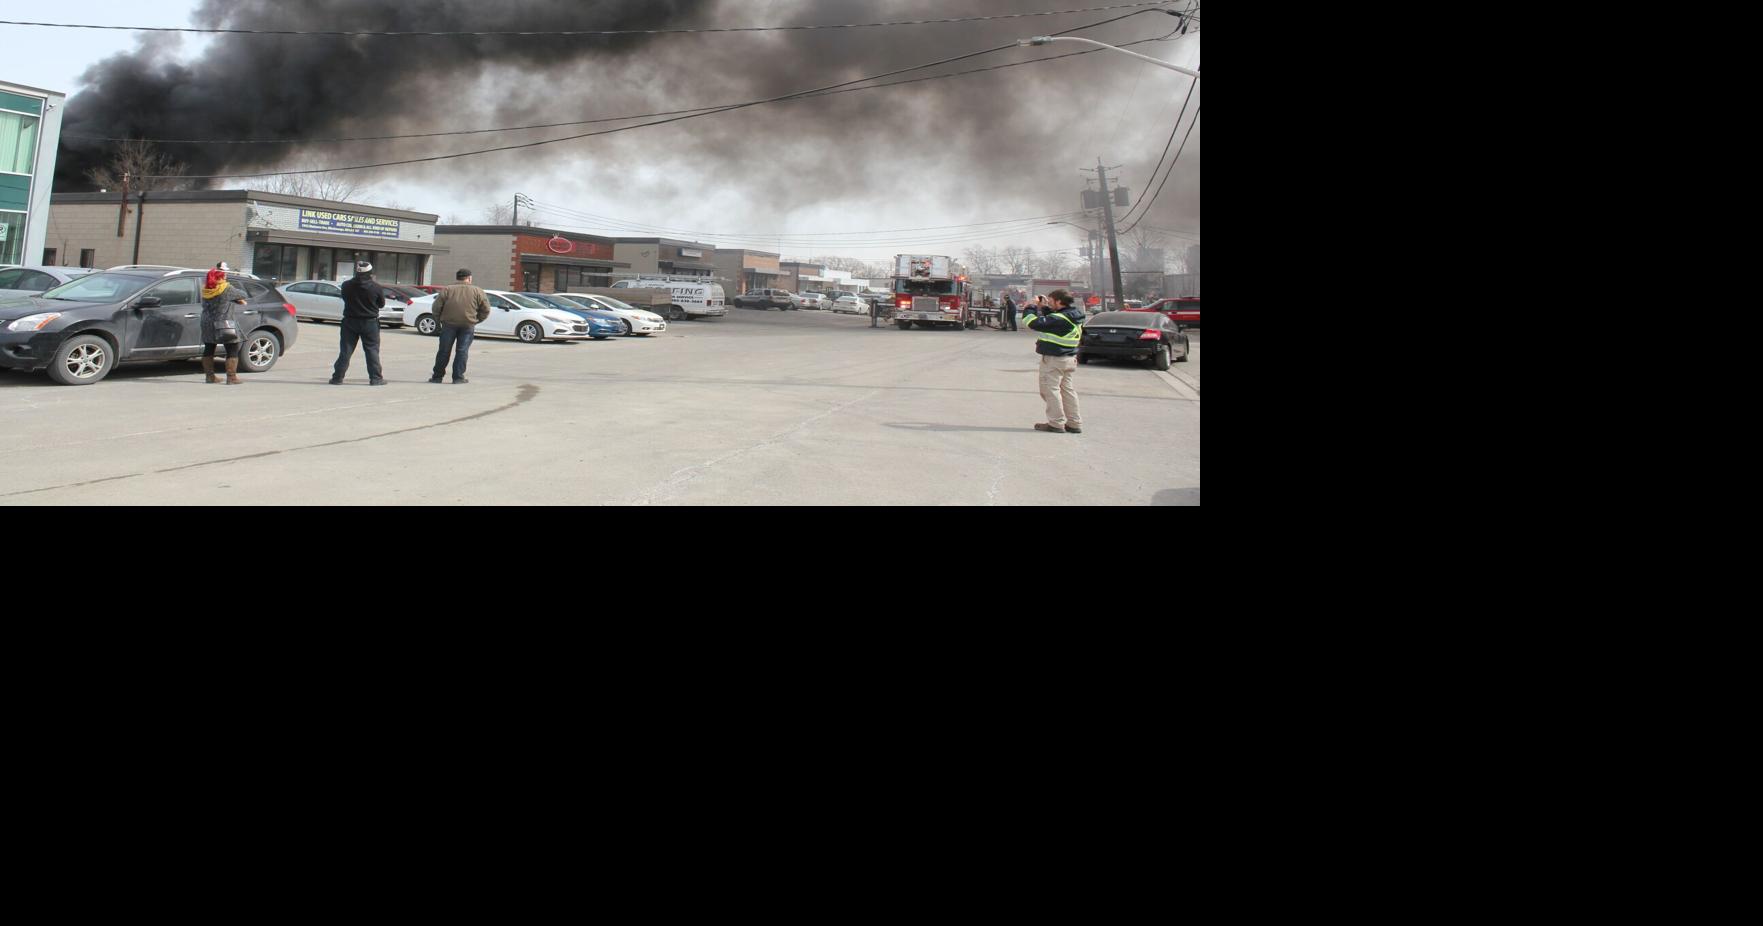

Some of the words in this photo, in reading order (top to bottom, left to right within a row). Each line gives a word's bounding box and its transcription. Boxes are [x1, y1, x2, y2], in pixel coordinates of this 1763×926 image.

[316, 211, 331, 219] USED
[333, 213, 347, 221] CARS
[375, 218, 398, 227] SERVICES
